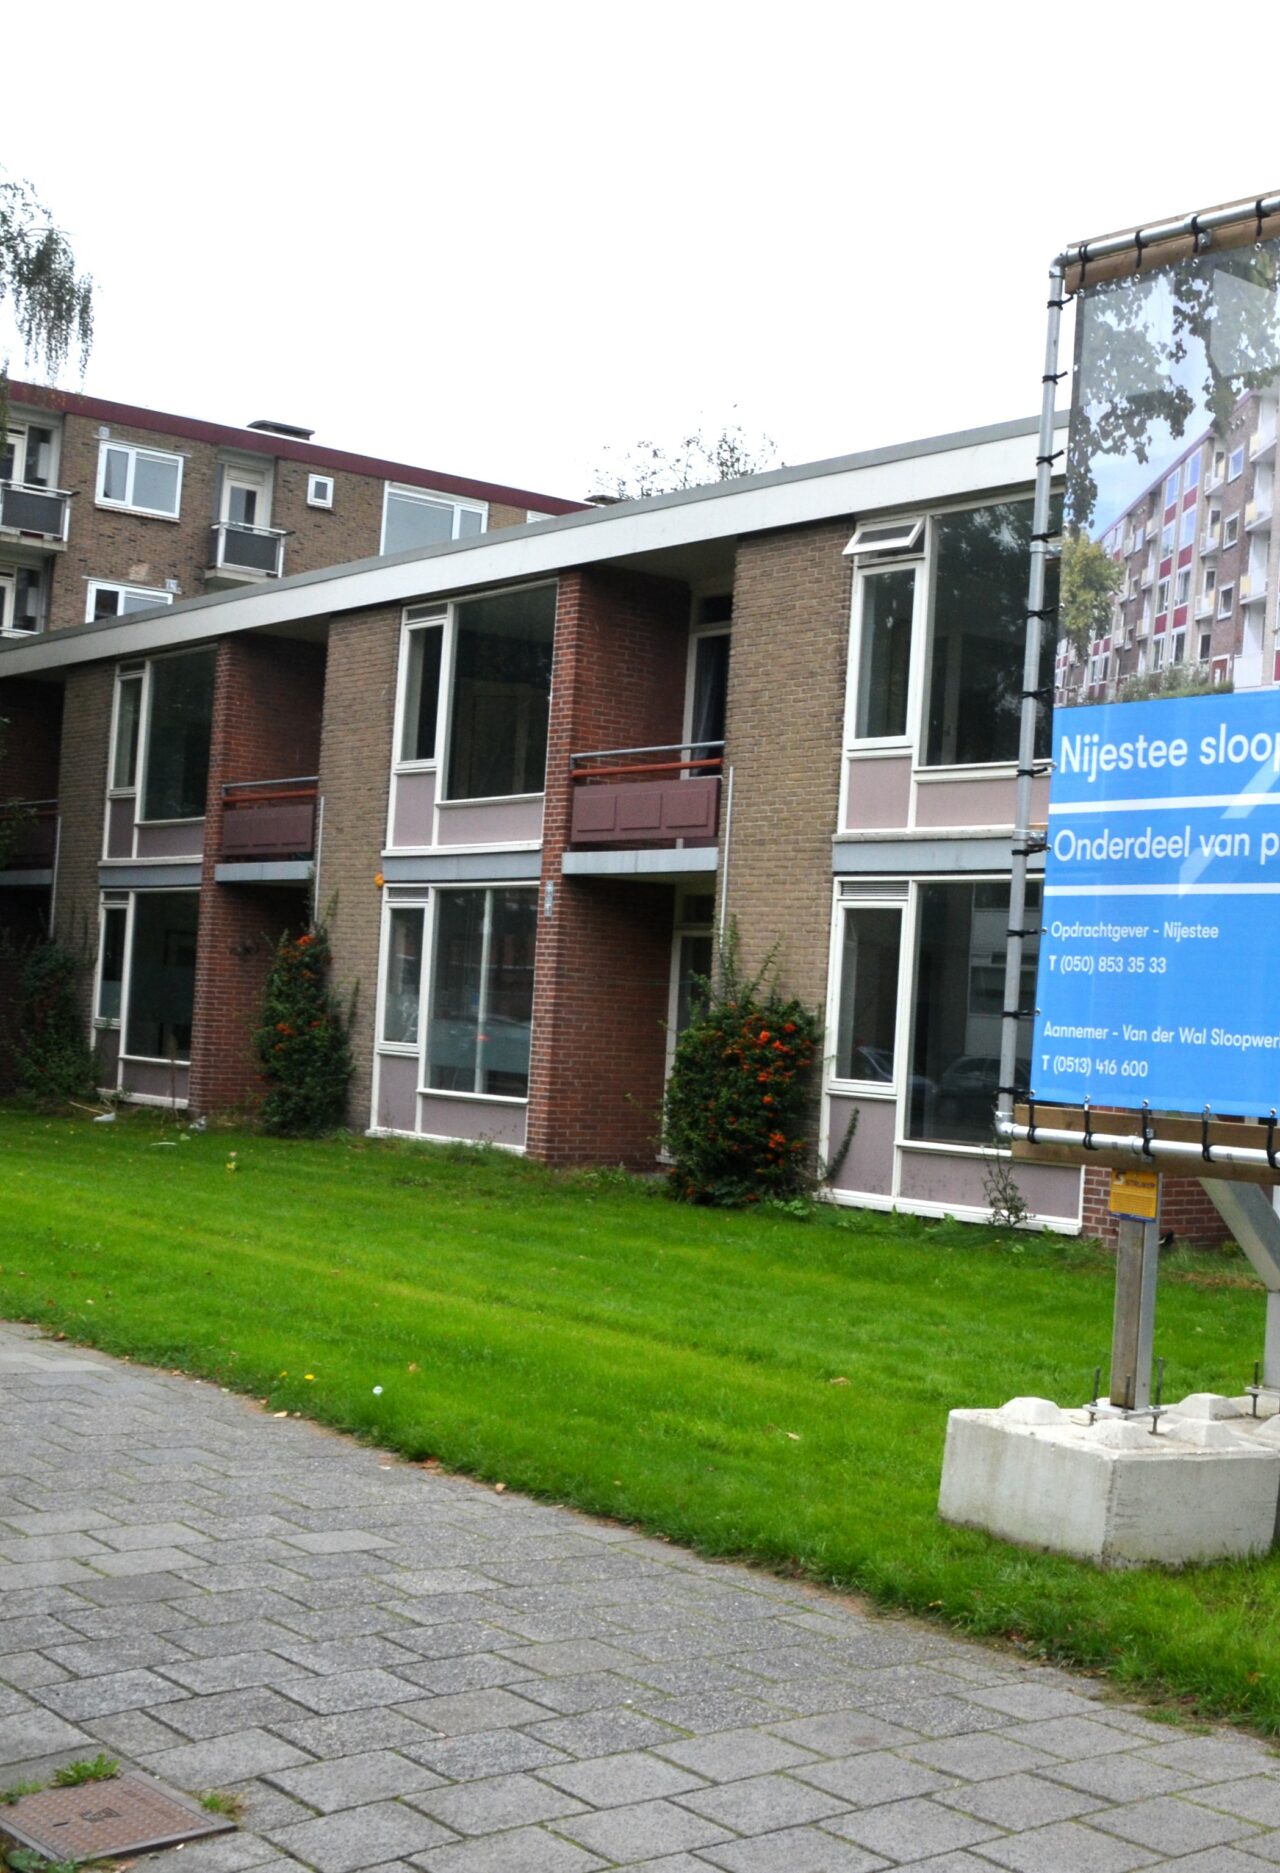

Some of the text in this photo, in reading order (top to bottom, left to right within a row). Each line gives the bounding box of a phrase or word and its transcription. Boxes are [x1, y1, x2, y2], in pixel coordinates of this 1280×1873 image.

[1060, 734, 1188, 783] Nijestee
[1054, 825, 1191, 861] Onderdeel
[1199, 832, 1250, 857] van
[1051, 921, 1149, 942] Opdrachtgever
[1163, 922, 1219, 942] Nijestee
[1049, 955, 1167, 975] T (050) 853 35 33
[1043, 1021, 1108, 1040] Aannemer
[1122, 1024, 1148, 1042] Van
[1151, 1026, 1174, 1043] der
[1179, 1027, 1206, 1045] Wal
[1042, 1055, 1148, 1077] T (0513) 416 600
